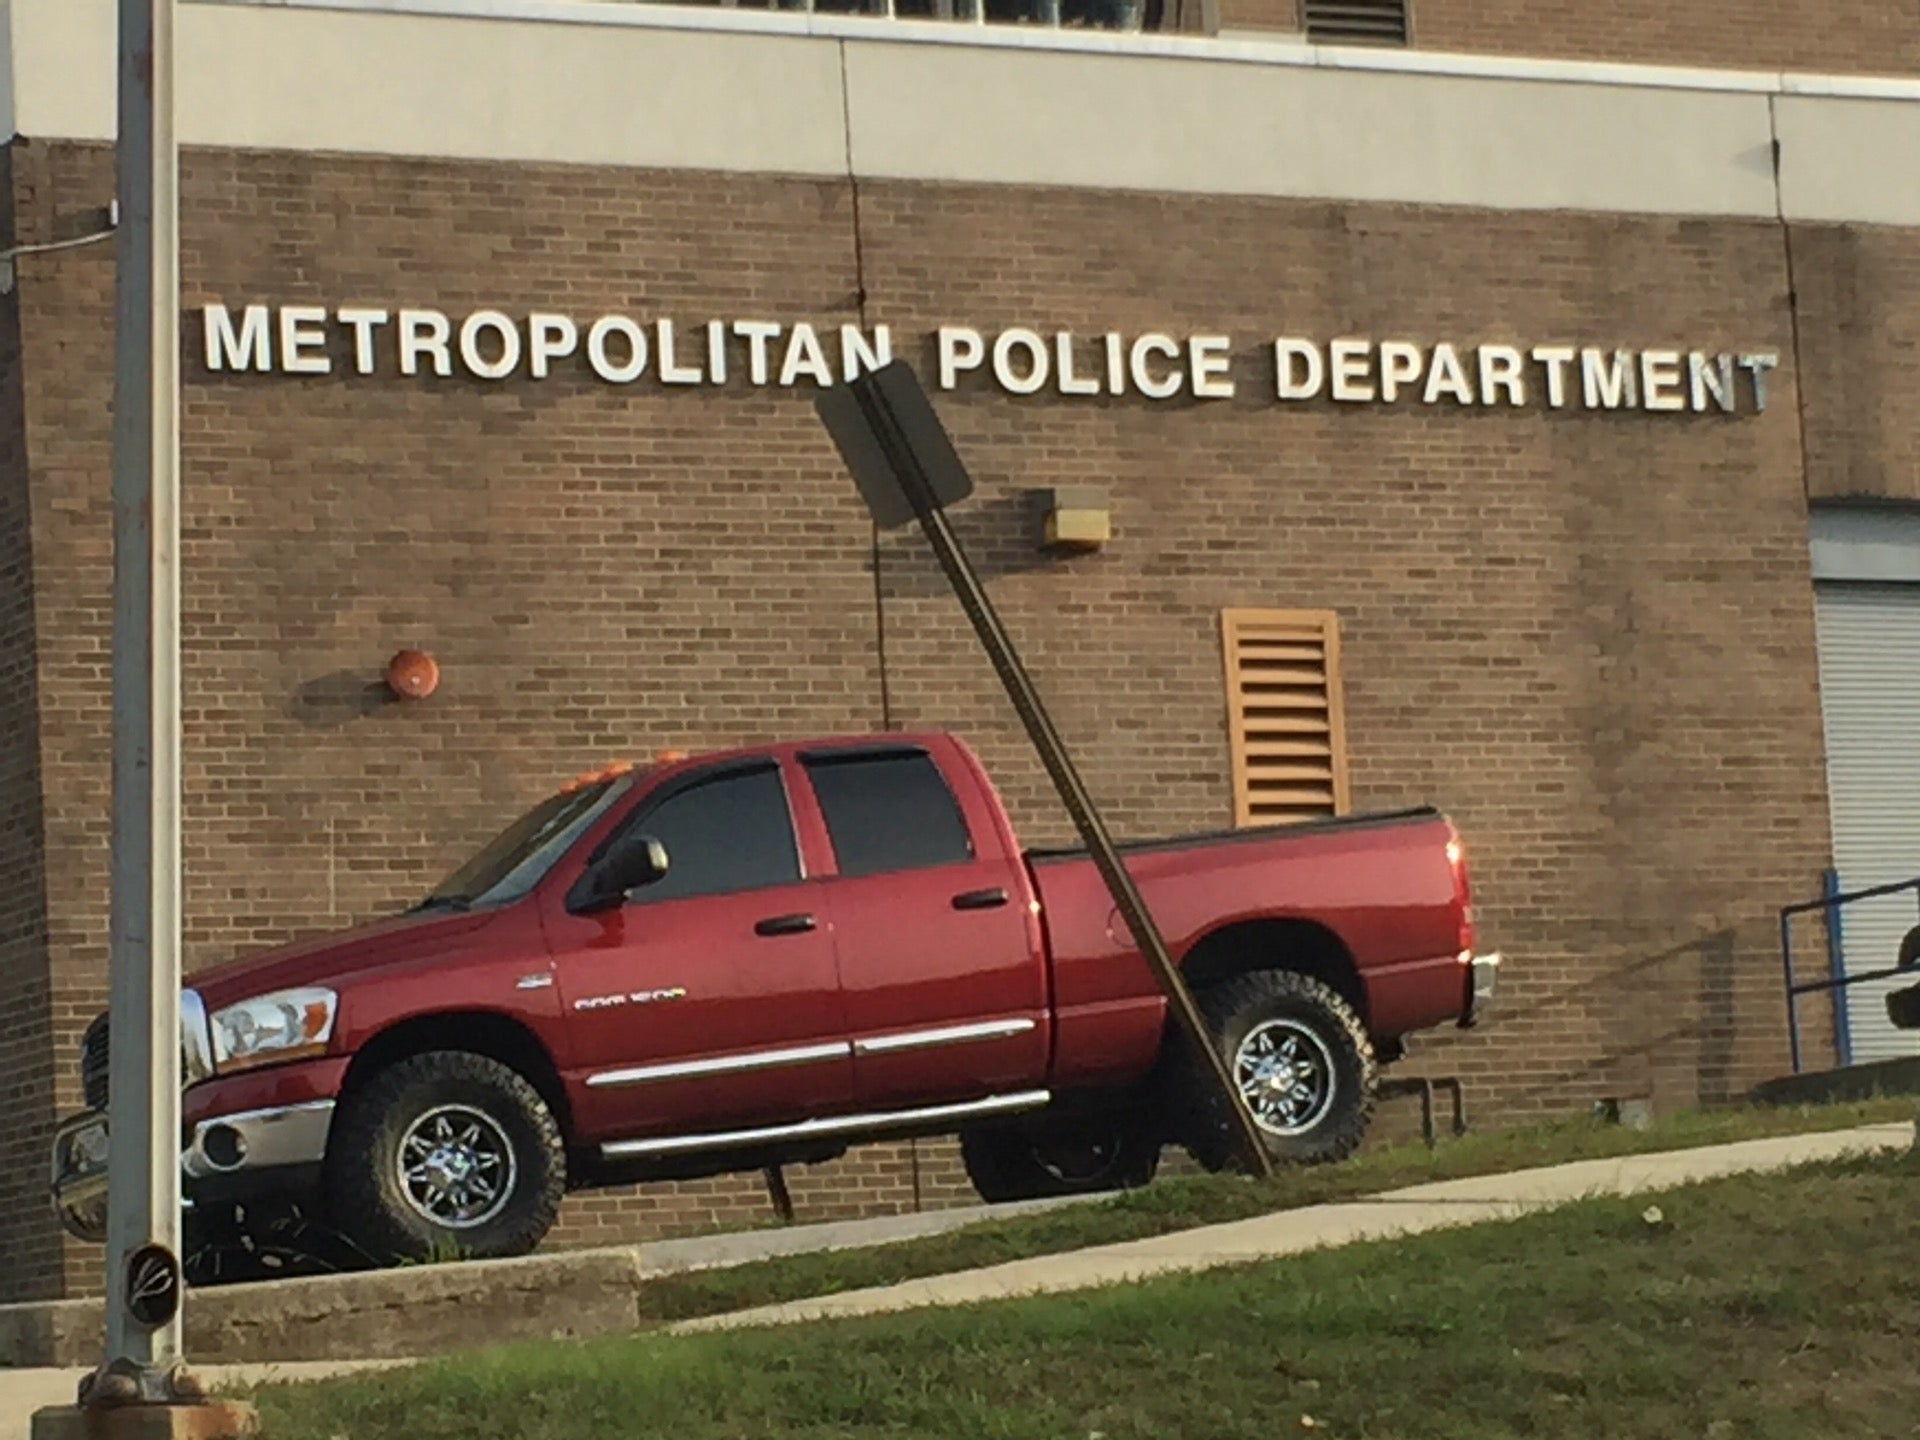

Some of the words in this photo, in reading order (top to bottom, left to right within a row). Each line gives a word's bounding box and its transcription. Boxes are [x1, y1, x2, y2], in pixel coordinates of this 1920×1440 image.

[203, 304, 892, 387] METROPOLITAN
[938, 326, 1235, 399] POLICE
[1275, 337, 1778, 413] DEPARTMENT
